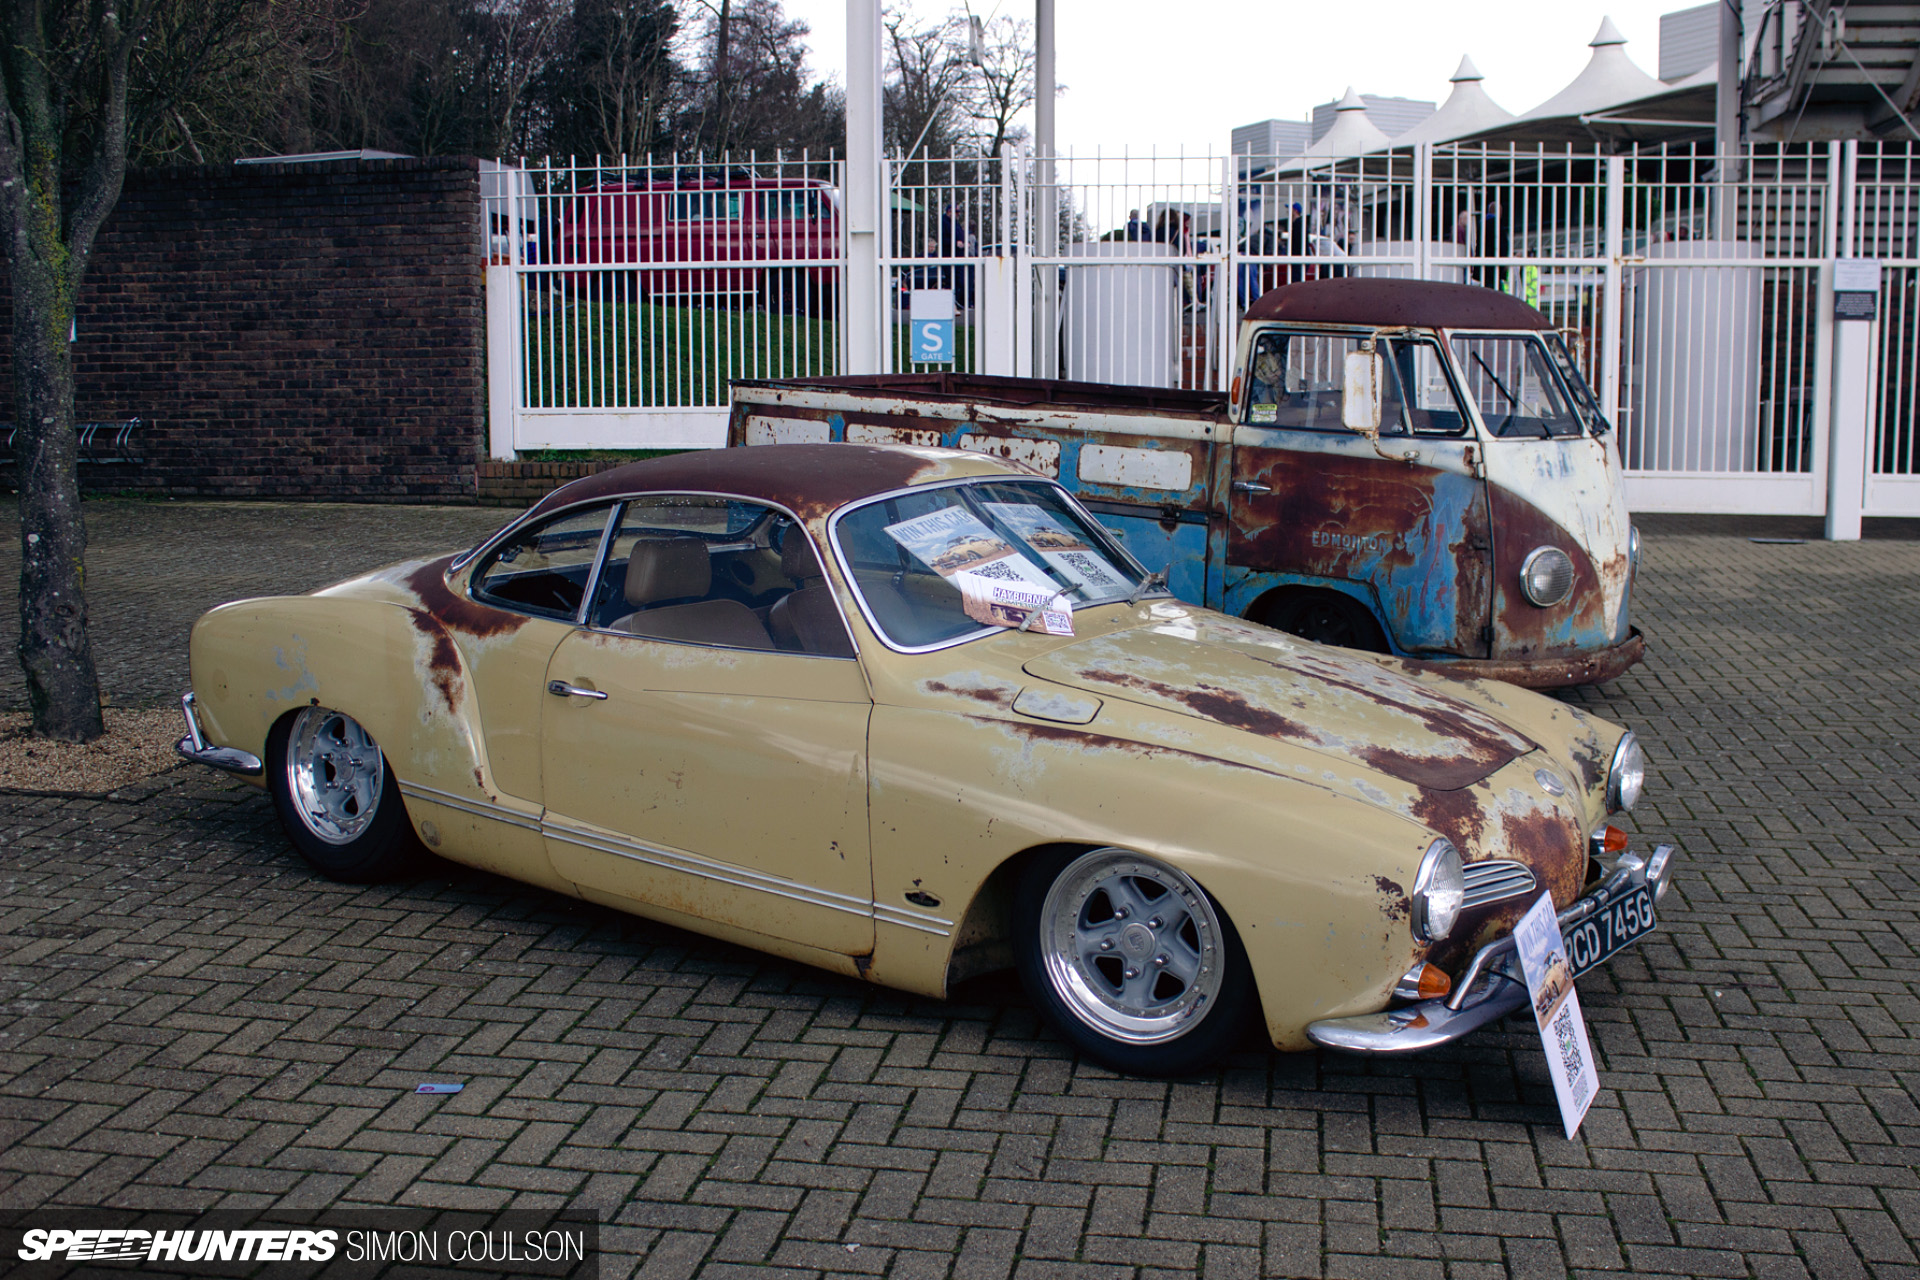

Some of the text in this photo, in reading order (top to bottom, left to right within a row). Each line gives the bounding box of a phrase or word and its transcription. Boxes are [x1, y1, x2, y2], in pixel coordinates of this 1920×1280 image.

[921, 322, 943, 352] S
[890, 523, 925, 543] WIN
[915, 515, 952, 535] THIS
[940, 508, 976, 527] CAR
[1601, 891, 1652, 951] 745G
